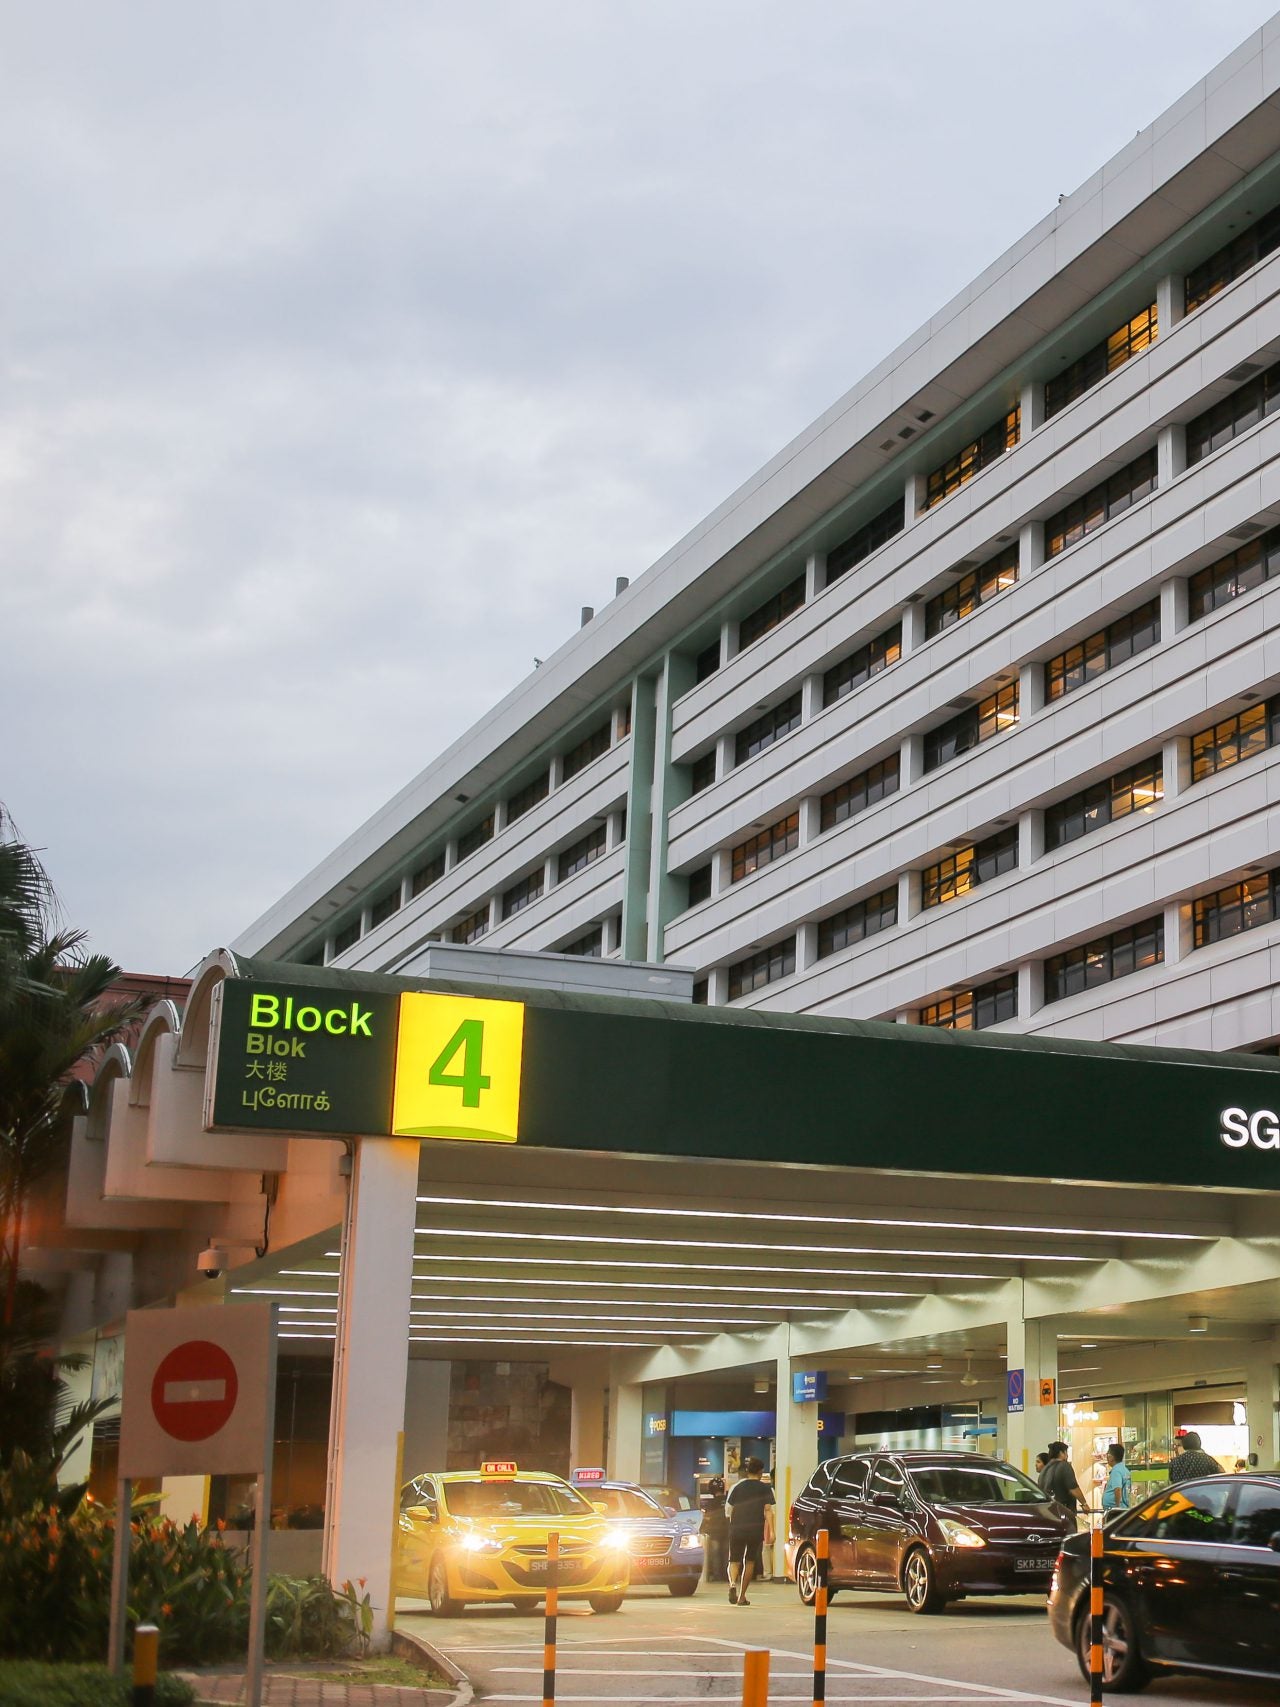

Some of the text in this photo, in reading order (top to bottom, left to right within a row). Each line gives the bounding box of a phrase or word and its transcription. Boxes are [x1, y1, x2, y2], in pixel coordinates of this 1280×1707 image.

[249, 993, 374, 1036] Block
[245, 1033, 306, 1058] Blok
[245, 1059, 288, 1082] 大楼
[428, 1018, 491, 1108] 4
